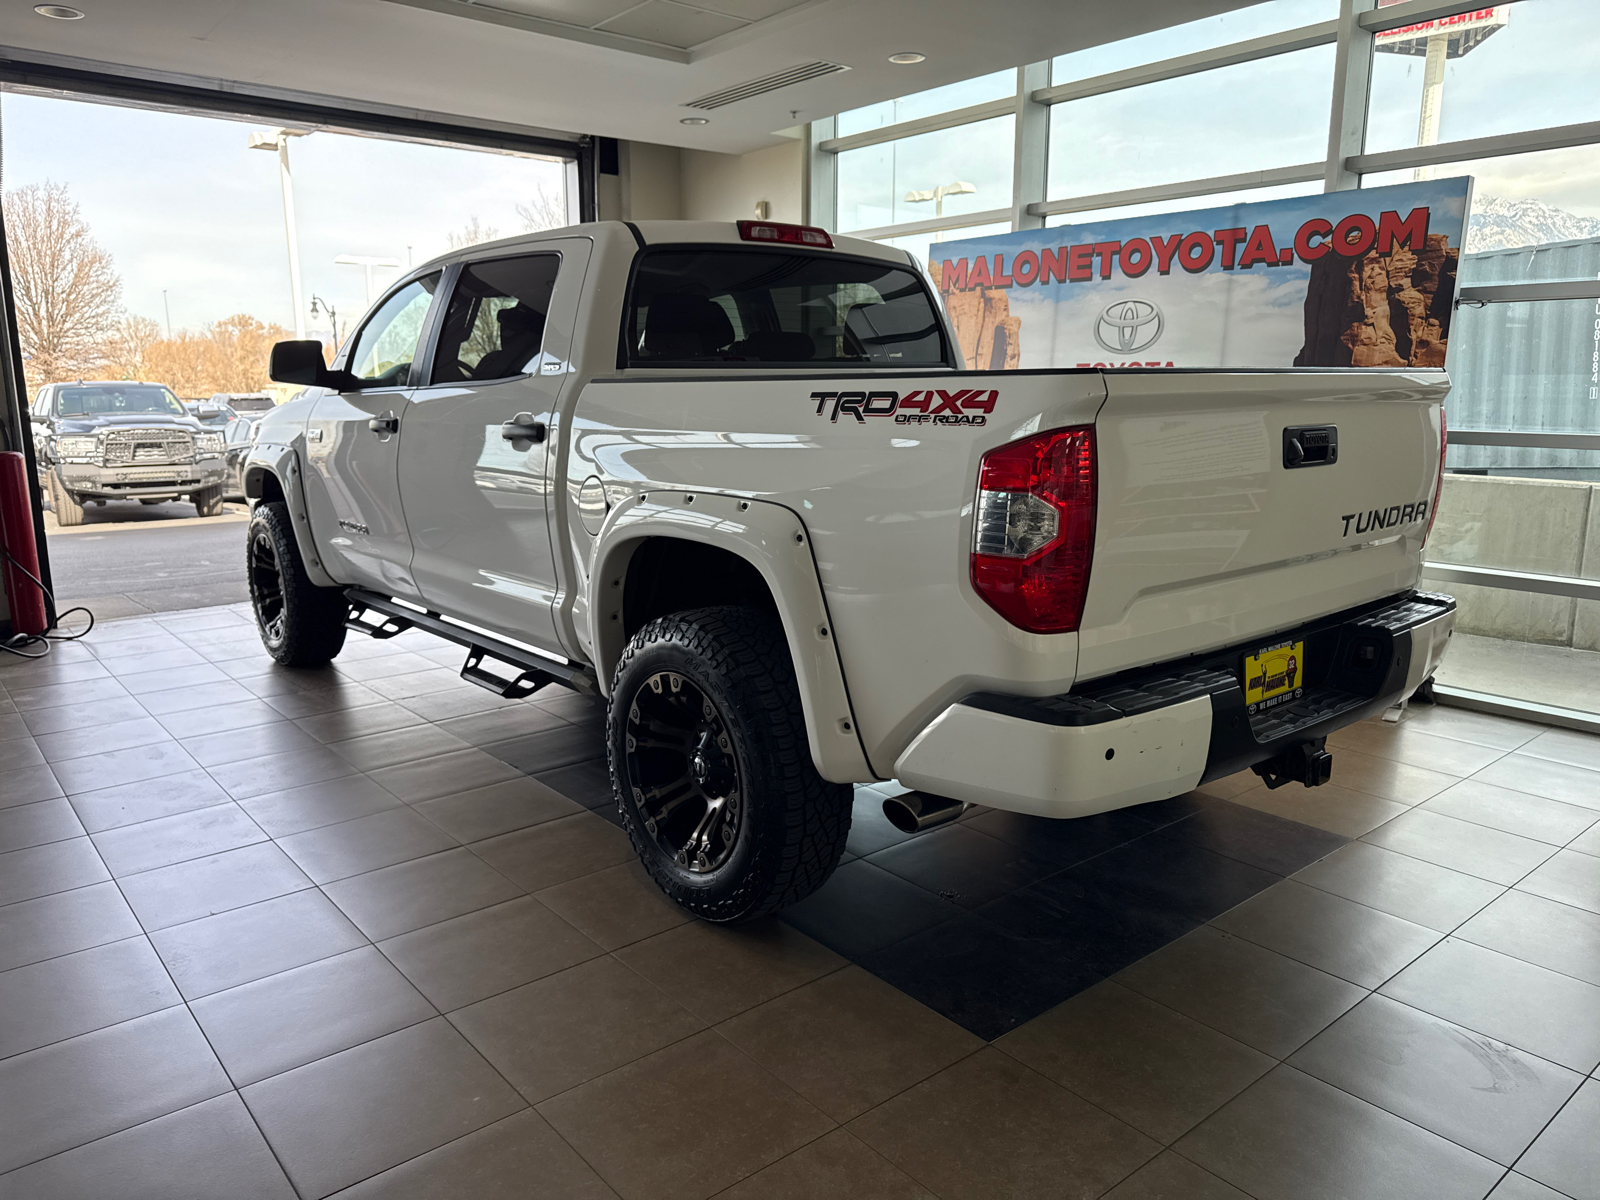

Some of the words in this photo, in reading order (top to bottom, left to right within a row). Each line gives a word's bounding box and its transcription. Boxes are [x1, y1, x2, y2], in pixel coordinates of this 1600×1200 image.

[941, 207, 1430, 293] MALONETOYOTA.COM
[810, 391, 900, 424] TRD
[899, 389, 999, 414] 4X4
[895, 414, 931, 426] OFF
[932, 414, 987, 426] ROAD
[1341, 499, 1428, 538] TUNDRA
[1289, 660, 1295, 669] 32
[1260, 702, 1266, 710] WE
[1267, 697, 1277, 707] MAKE
[1283, 692, 1292, 702] EASY
